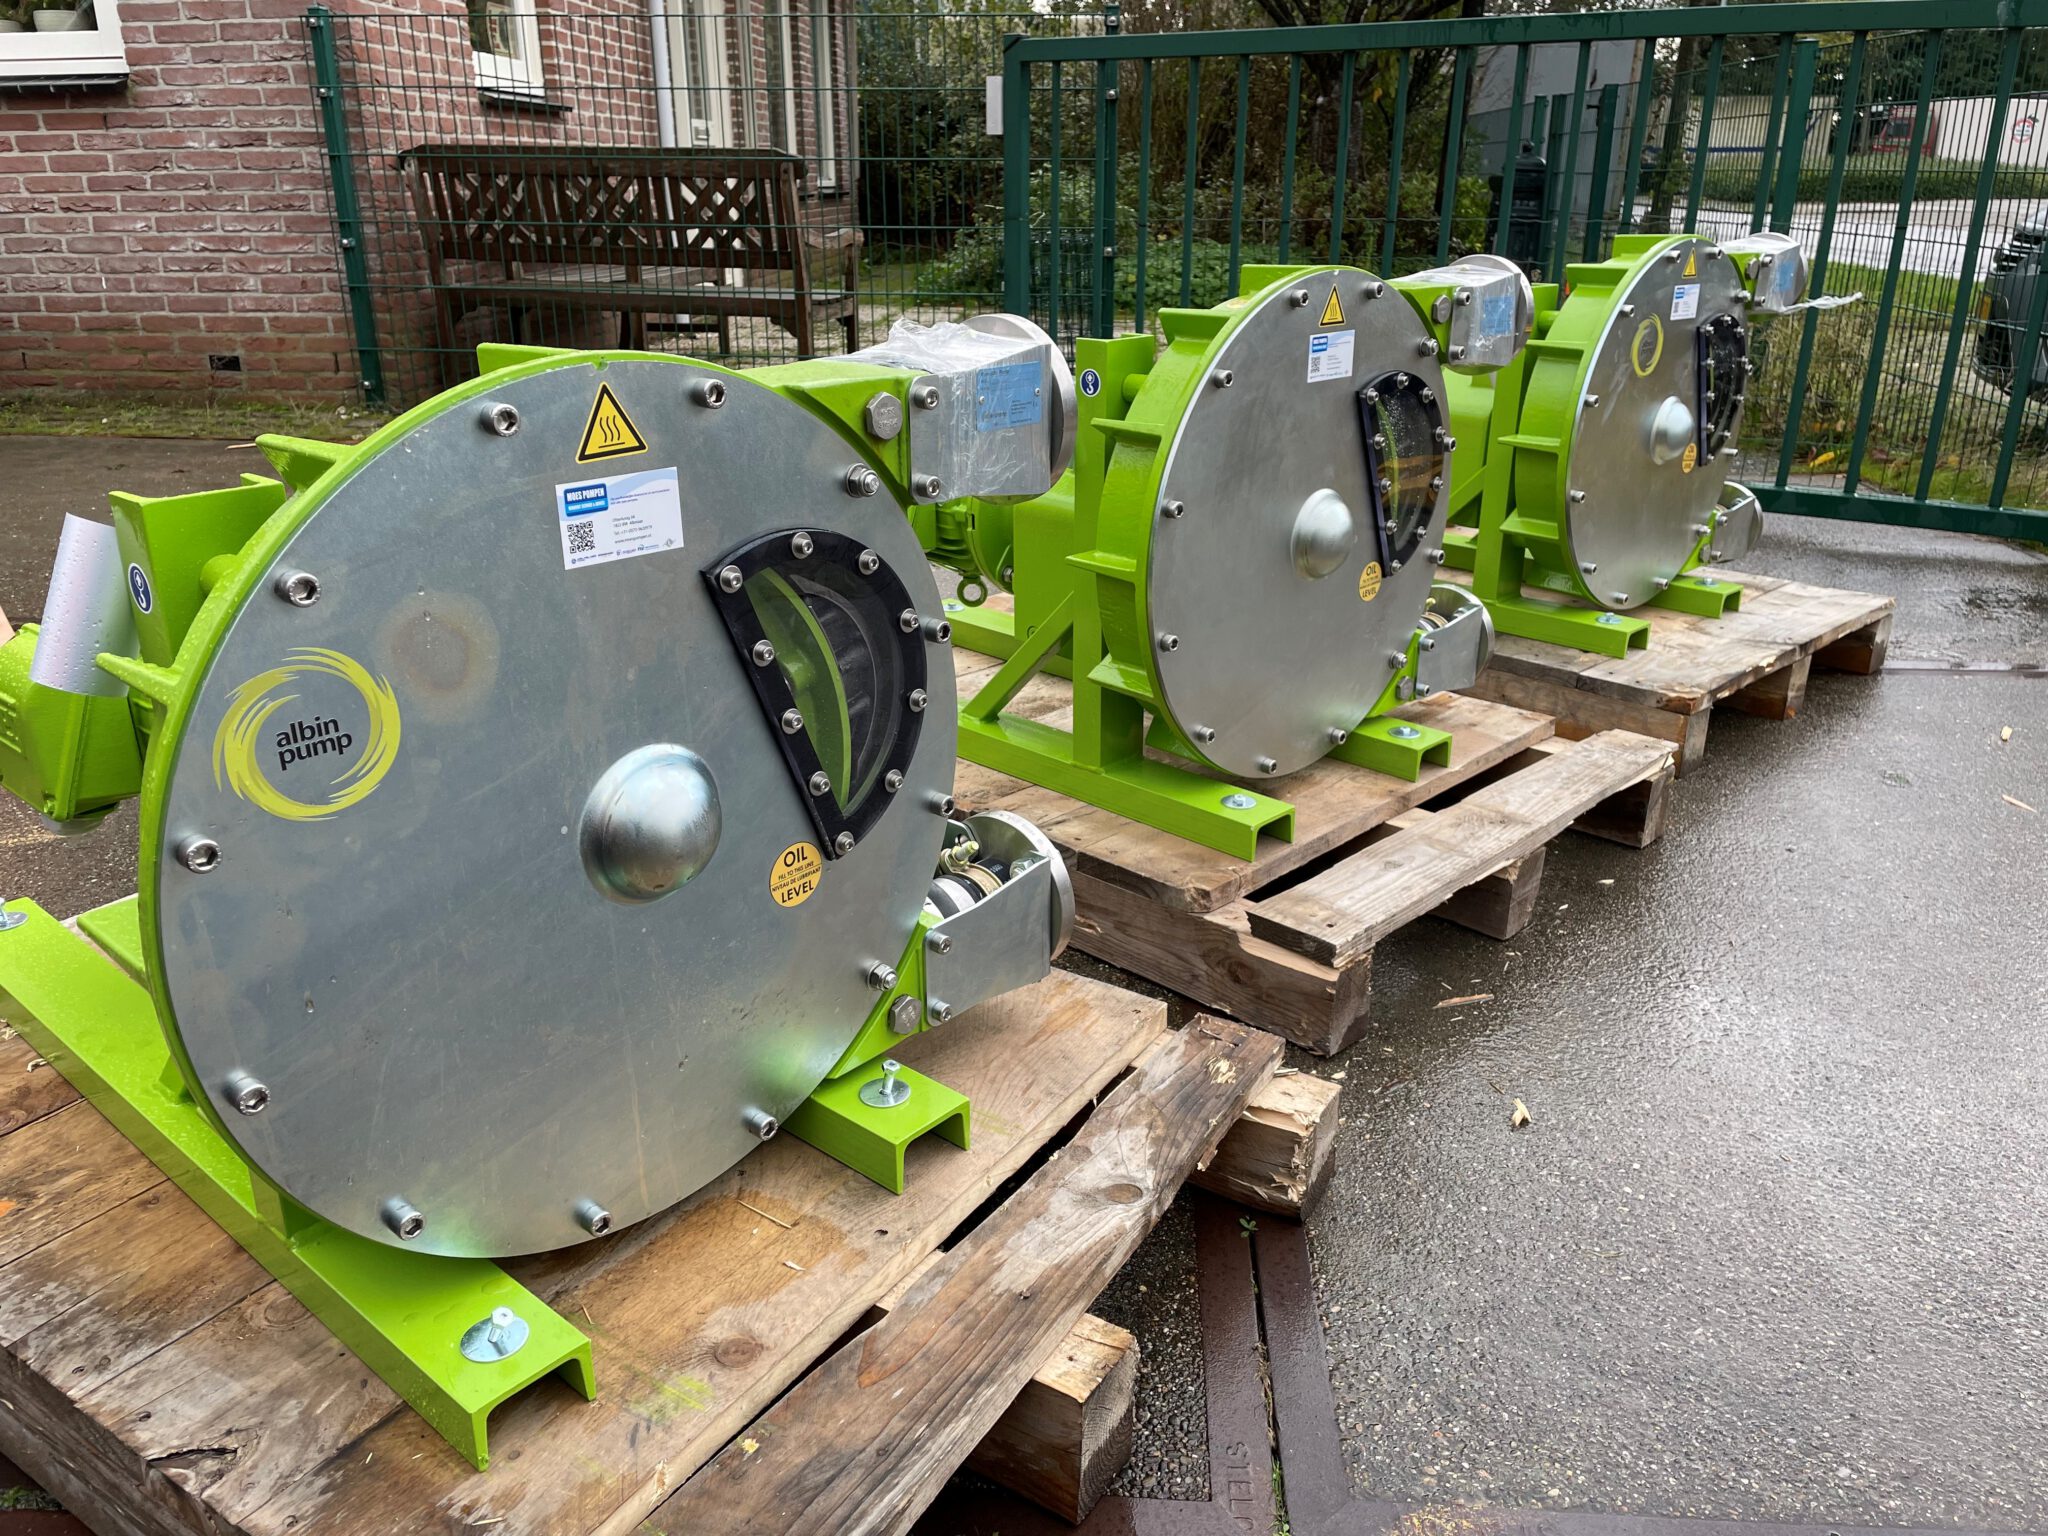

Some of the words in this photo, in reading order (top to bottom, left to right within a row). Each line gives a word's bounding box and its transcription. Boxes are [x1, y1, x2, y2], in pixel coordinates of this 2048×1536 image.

[566, 491, 582, 502] MOES
[582, 487, 605, 499] POMPEN
[1366, 563, 1377, 576] OIL
[1362, 586, 1377, 598] LEVEL
[276, 716, 340, 748] albin
[278, 732, 353, 771] pump
[784, 846, 808, 867] OIL
[772, 880, 789, 892] NIVEAU
[797, 866, 821, 882] LUBRIFIANT
[778, 872, 786, 881] FILL
[787, 869, 794, 877] TO
[794, 864, 804, 873] THIS
[804, 861, 814, 869] LINE
[781, 880, 814, 904] LEVEL
